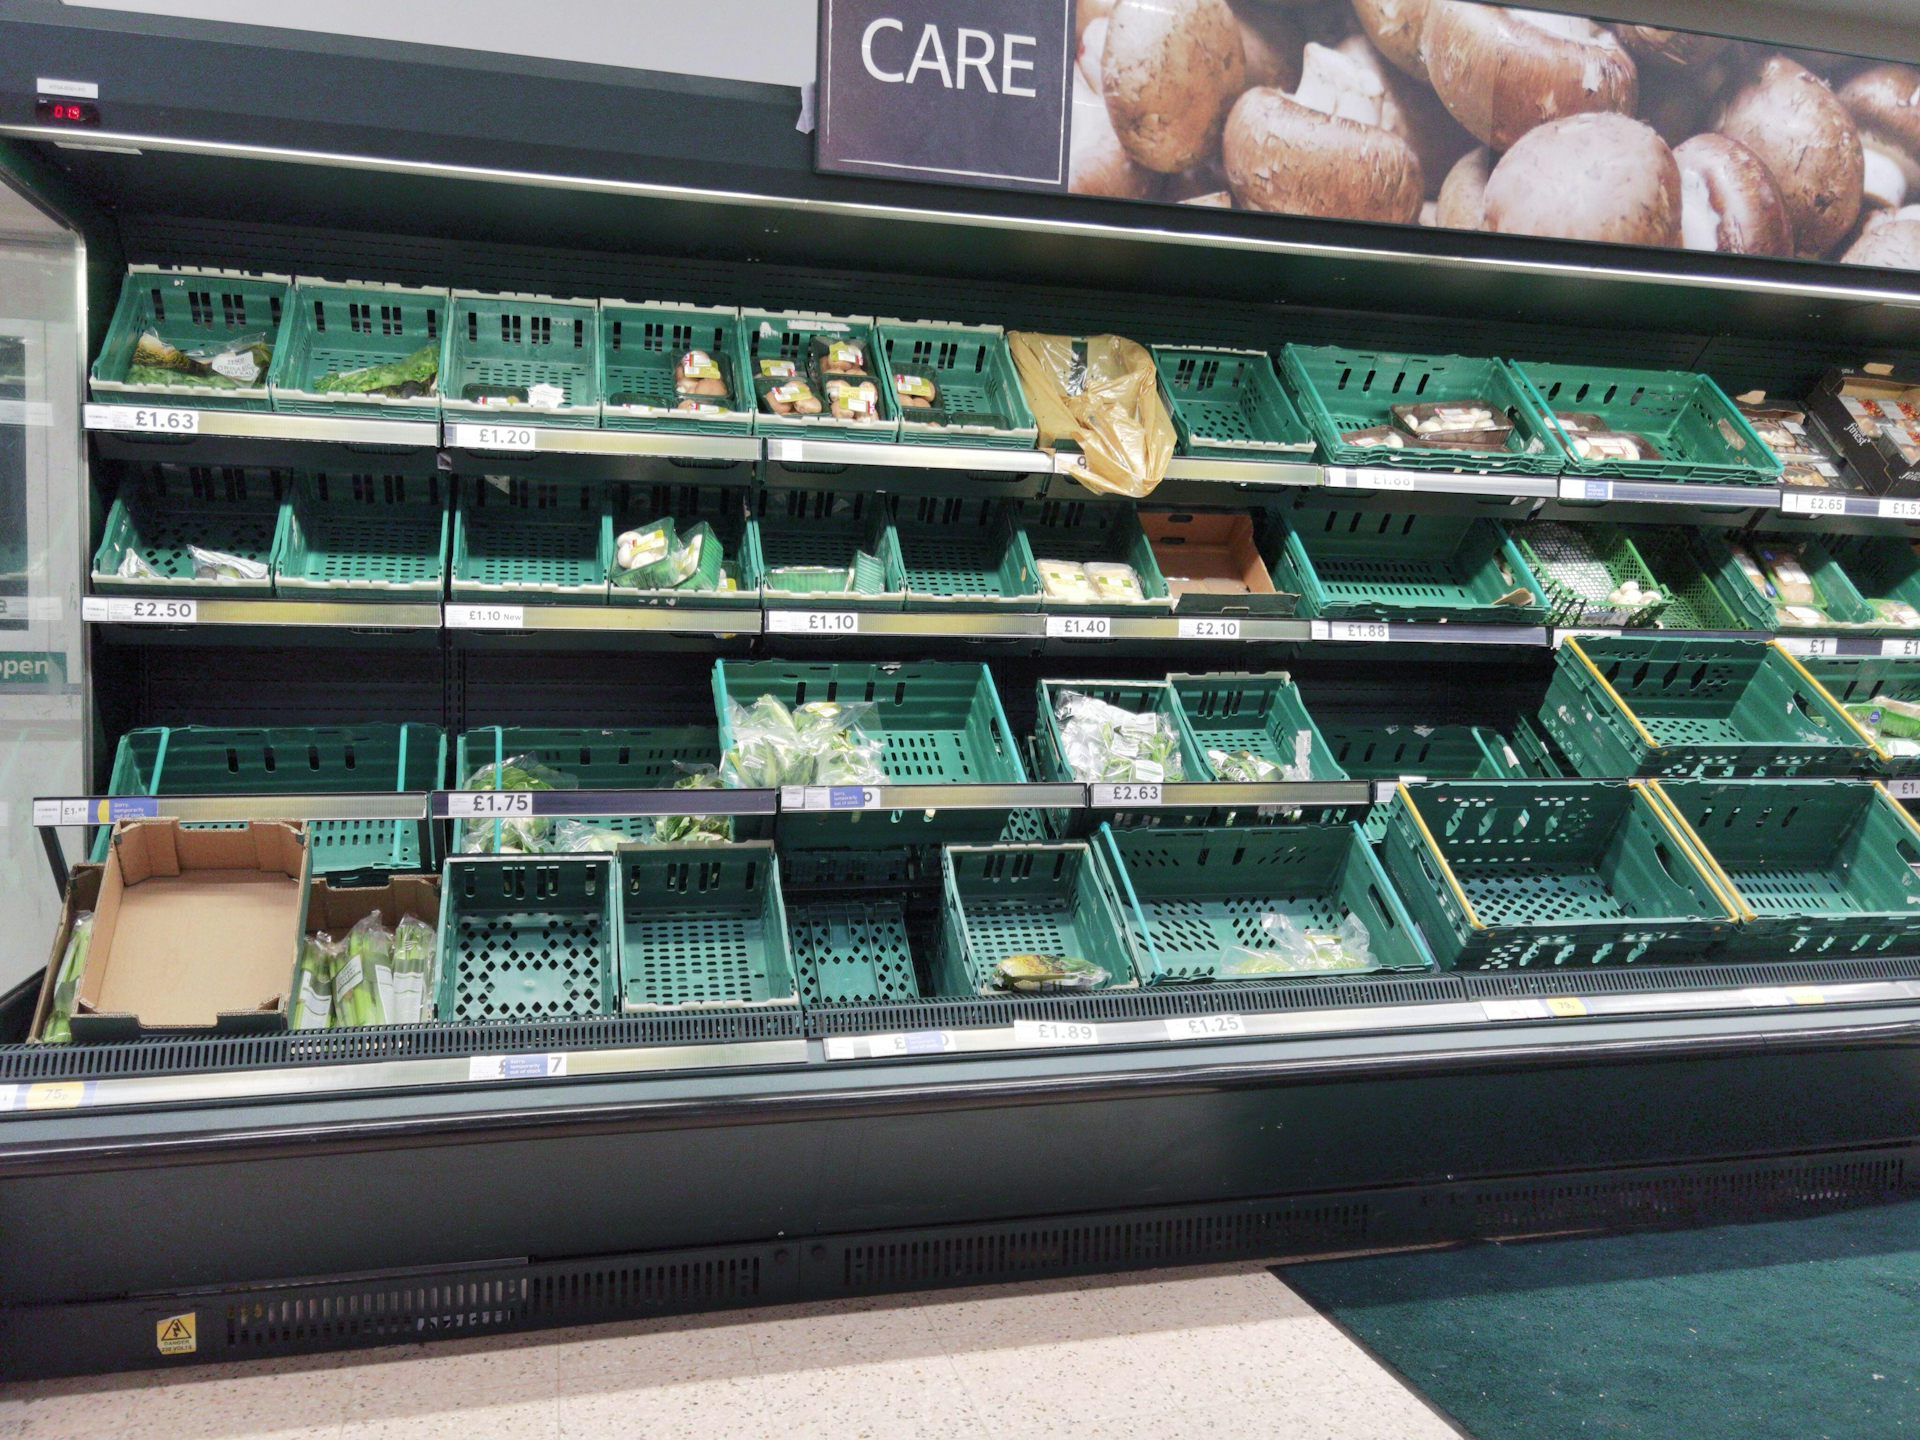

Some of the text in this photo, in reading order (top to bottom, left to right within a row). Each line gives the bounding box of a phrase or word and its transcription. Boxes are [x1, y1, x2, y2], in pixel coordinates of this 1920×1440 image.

[861, 17, 1036, 98] CARE
[135, 410, 194, 430] £1.63
[479, 428, 531, 445] £1.20
[1810, 498, 1843, 511] £2.65
[134, 602, 192, 618] £2.50
[469, 610, 501, 621] £1.10
[808, 614, 854, 630] £1.10
[1064, 619, 1106, 634] £1.40
[1196, 622, 1237, 636] £2.10
[1348, 624, 1386, 638] £1.88
[1809, 639, 1826, 654] £1
[1113, 786, 1159, 800] £2.63
[473, 795, 528, 811] £1.75
[1038, 1024, 1092, 1040] £1.89
[1188, 1016, 1239, 1034] £1.25
[551, 1057, 562, 1073] 7
